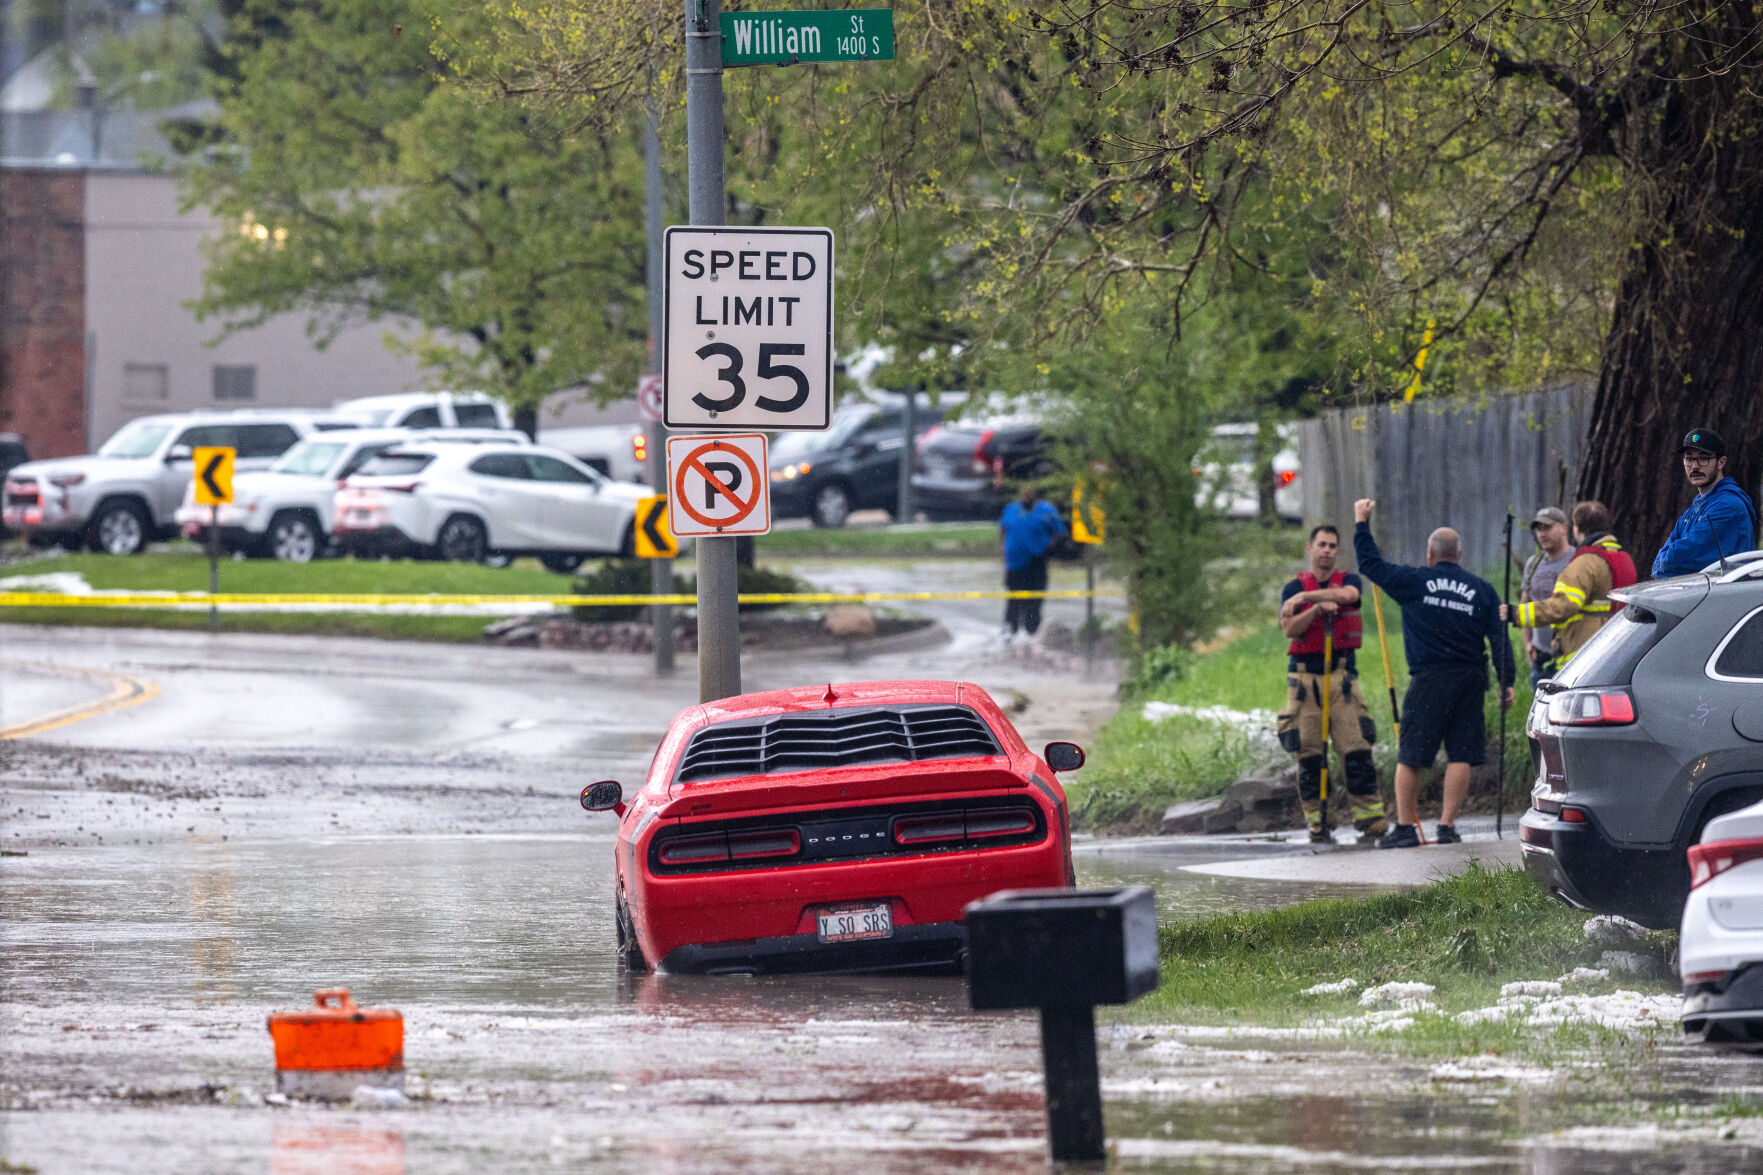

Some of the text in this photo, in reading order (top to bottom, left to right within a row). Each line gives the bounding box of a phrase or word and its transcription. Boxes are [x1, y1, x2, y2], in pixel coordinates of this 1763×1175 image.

[733, 15, 864, 55] William St
[836, 36, 880, 55] 1400 S
[682, 249, 816, 281] SPEED
[696, 295, 800, 326] LIMIT
[691, 342, 810, 413] 35
[704, 461, 743, 509] P
[1426, 577, 1476, 602] OMAHA
[809, 831, 885, 843] DODGE
[821, 918, 829, 937] Y
[863, 913, 889, 932] SRS
